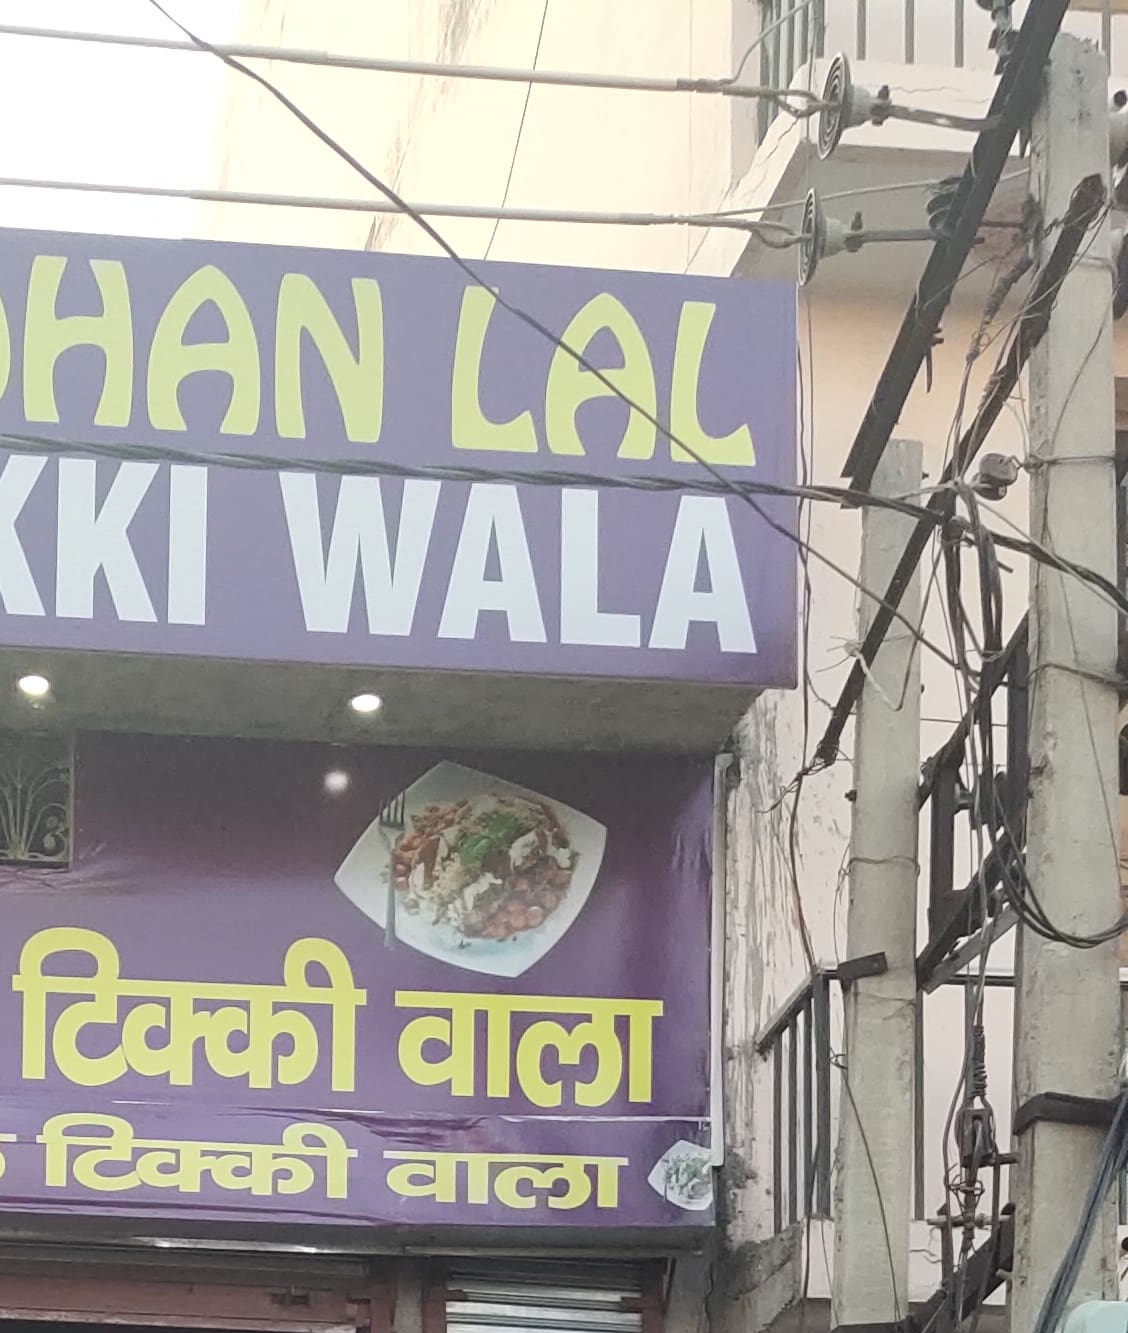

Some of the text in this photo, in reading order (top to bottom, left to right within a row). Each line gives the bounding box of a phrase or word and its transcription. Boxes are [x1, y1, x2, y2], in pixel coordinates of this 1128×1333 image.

[451, 286, 755, 466] LAL
[278, 471, 759, 655] WALA
[10, 926, 368, 1093] टिक्की
[394, 989, 665, 1108] वाला
[36, 1112, 358, 1199] टिक्की
[385, 1150, 628, 1210] वाला
